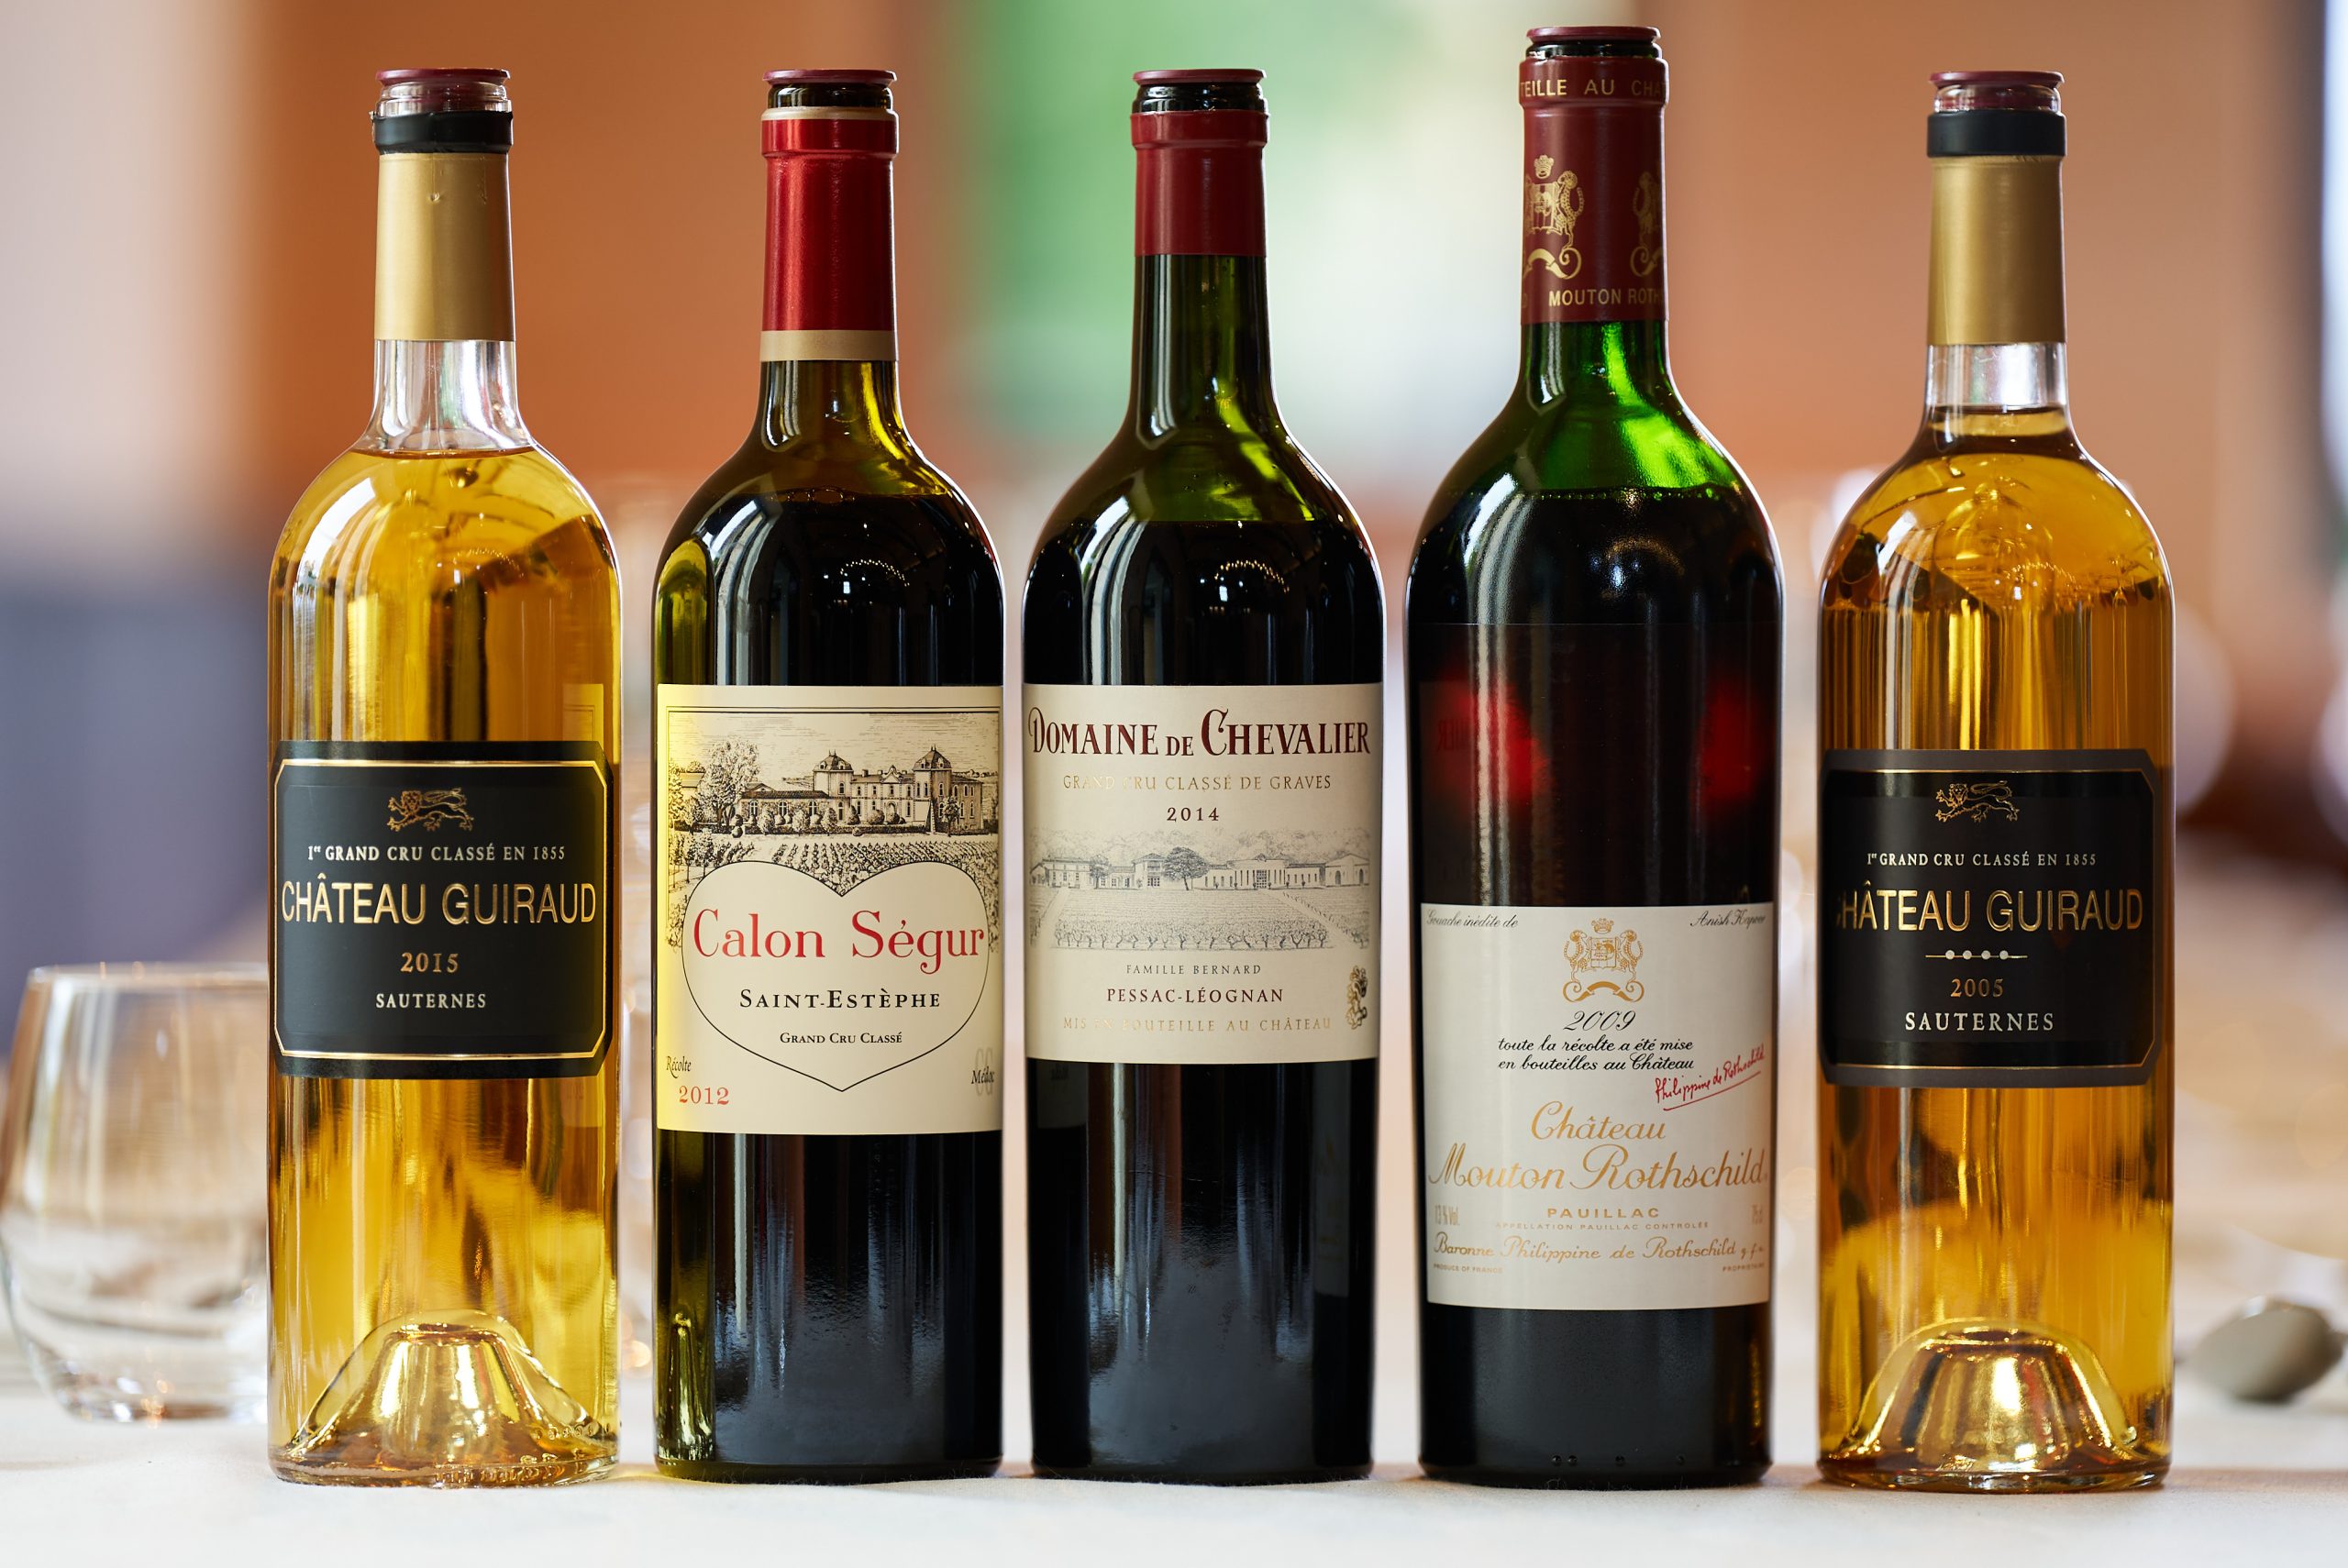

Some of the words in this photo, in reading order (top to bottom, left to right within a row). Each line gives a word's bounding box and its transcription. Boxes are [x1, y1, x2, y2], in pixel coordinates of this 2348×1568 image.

[1584, 79, 1615, 96] AU
[1548, 289, 1622, 308] MOUTON
[1027, 706, 1158, 756] DOMAINE
[1165, 735, 1193, 756] DE
[1201, 708, 1371, 756] CHEVALIER
[1063, 775, 1115, 790] GRAND
[1123, 776, 1157, 790] CRU
[1166, 774, 1232, 791] CLASSÉ
[1240, 776, 1262, 790] DE
[1269, 775, 1331, 790] GRAVES
[1167, 807, 1219, 822] 2014
[325, 845, 380, 861] GRAND
[387, 846, 423, 861] CRU
[431, 843, 495, 861] CLASSÉ
[503, 846, 526, 860] EN
[533, 846, 566, 860] 1855
[1879, 853, 1928, 866] GRAND
[1933, 854, 1965, 866] CRU
[1973, 851, 2030, 866] CLASSÉ
[2038, 854, 2057, 866] EN
[2066, 854, 2097, 866] 1855
[282, 872, 426, 924] CHÂTEAU
[441, 882, 597, 925] GUIRAUD
[1689, 910, 1733, 927] Anish
[1986, 889, 2143, 932] GUIRAUD
[1463, 914, 1501, 928] inédite
[1503, 914, 1519, 928] de
[693, 909, 825, 958] Calon
[851, 910, 985, 975] Ségur
[401, 952, 460, 974] 2015
[1126, 965, 1184, 975] FAMILLE
[1193, 965, 1261, 975] BERNARD
[1107, 987, 1283, 1003] PESSAC-LÉOGNAN
[1951, 978, 2004, 998] 2005
[375, 993, 486, 1009] SAUTERNES
[1064, 1017, 1086, 1029] MIS
[1122, 1019, 1215, 1032] BOUTEILLE
[1226, 1020, 1249, 1032] AU
[1259, 1016, 1331, 1032] CHÂTEAU
[1563, 1010, 1636, 1031] 2009
[1905, 1011, 2054, 1032] SAUTERNES
[1498, 1037, 1534, 1051] toute
[1538, 1034, 1556, 1052] la
[1562, 1033, 1615, 1052] récolte
[1618, 1042, 1631, 1052] a
[1634, 1038, 1657, 1052] été
[1659, 1038, 1694, 1051] mise
[666, 1055, 692, 1079] Récolte
[1498, 1060, 1515, 1069] en
[1521, 1054, 1598, 1070] bouteilles
[1602, 1060, 1626, 1070] au
[1629, 1052, 1695, 1070] Château
[1655, 1075, 1711, 1103] Philippine
[1712, 1067, 1722, 1085] de
[679, 1085, 729, 1105] 2012
[1531, 1100, 1666, 1141] Château
[1428, 1143, 1565, 1190] Mouton
[1569, 1143, 1766, 1190] Rothschild
[1547, 1208, 1659, 1219] PAUILLAC
[1497, 1222, 1573, 1231] APPELLATION
[1434, 1231, 1494, 1256] Baronne
[1500, 1235, 1601, 1264] Philippine
[1610, 1244, 1635, 1259] de
[1643, 1236, 1736, 1259] Rothschild
[1472, 1265, 1504, 1274] FRANCE
